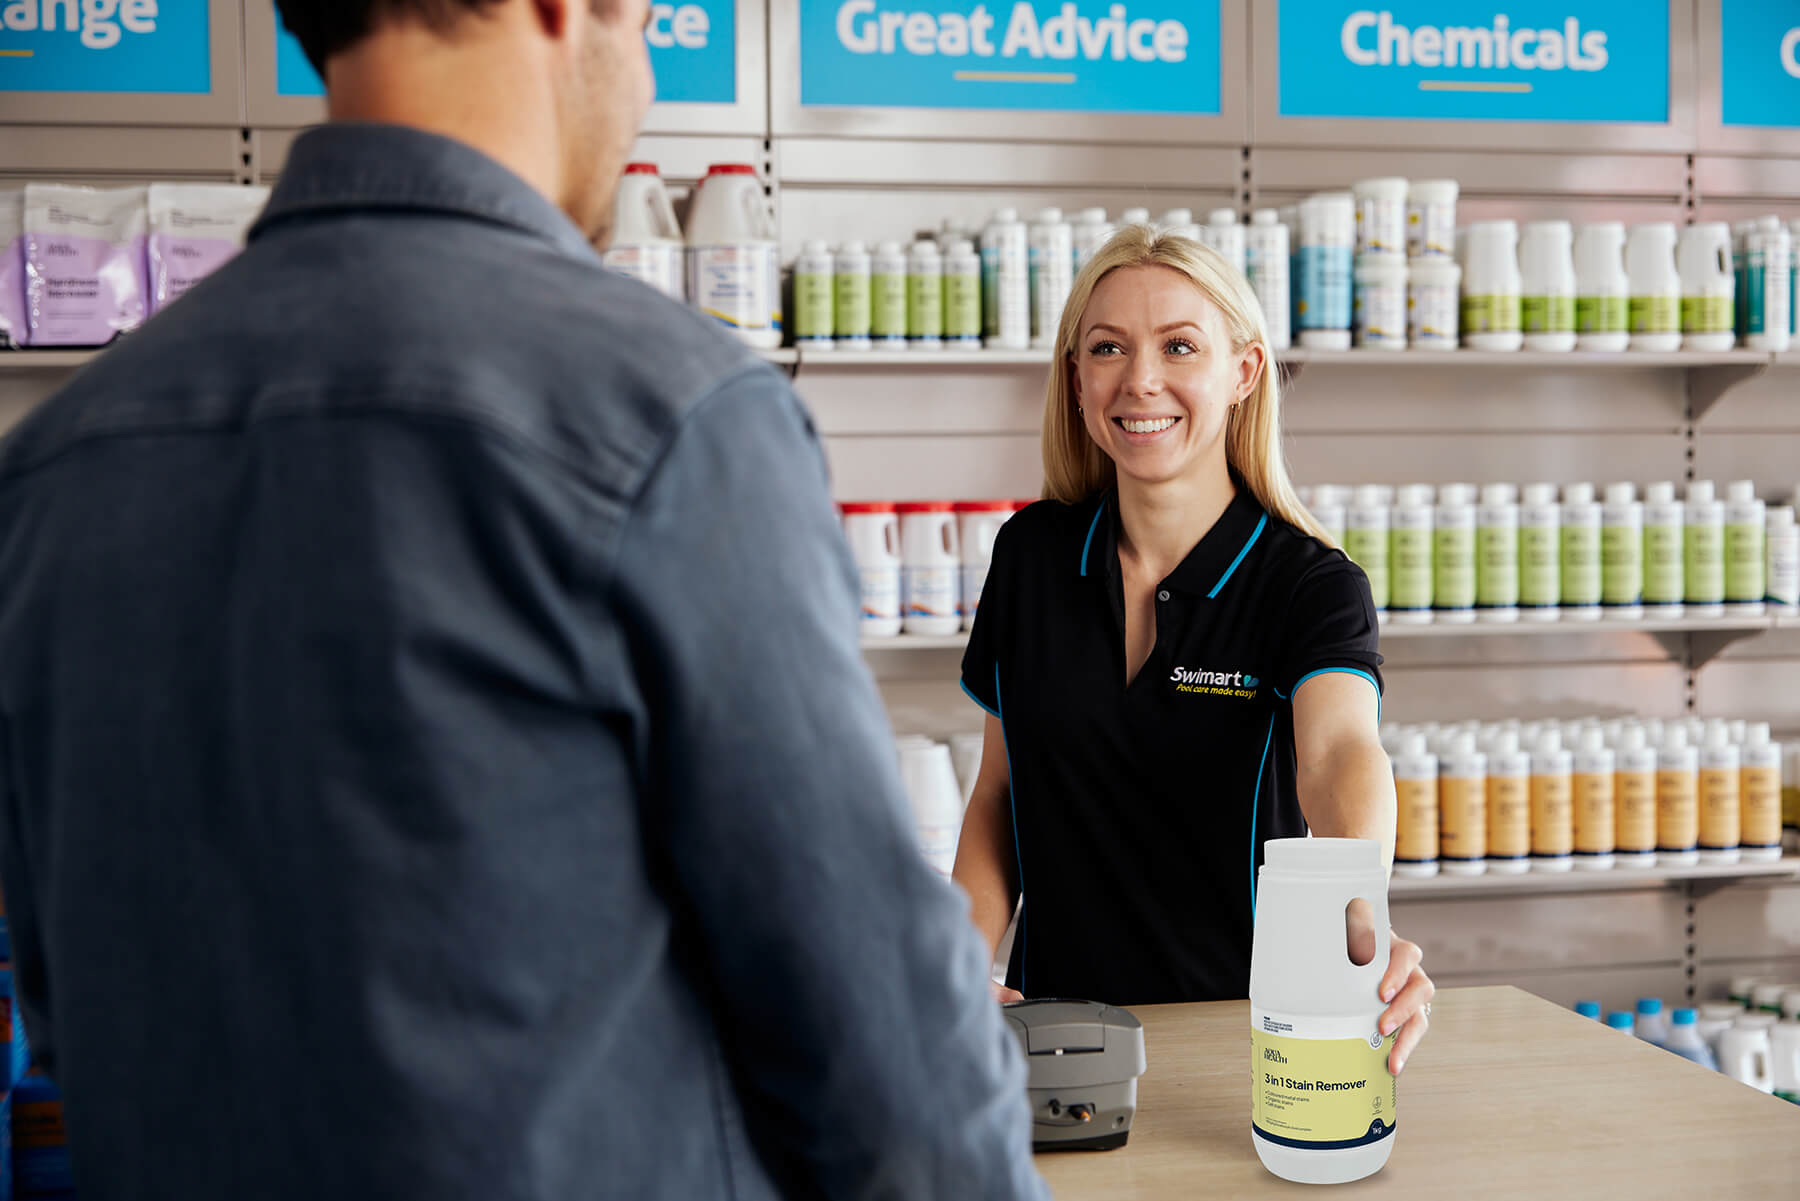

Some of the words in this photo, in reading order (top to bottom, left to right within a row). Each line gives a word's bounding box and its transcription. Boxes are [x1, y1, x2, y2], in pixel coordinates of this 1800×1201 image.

[0, 0, 158, 49] ange
[646, 4, 709, 48] ce
[835, 0, 995, 57] Great
[1001, 1, 1189, 63] Advice
[1341, 10, 1609, 71] Chemicals
[1170, 667, 1242, 687] Swimart
[1176, 684, 1193, 692] Pool
[1210, 687, 1233, 696] made
[1265, 1073, 1270, 1083] 3
[1271, 1075, 1279, 1086] in
[1280, 1077, 1285, 1087] 1
[1285, 1078, 1314, 1090] Stain
[1316, 1080, 1366, 1091] Remover
